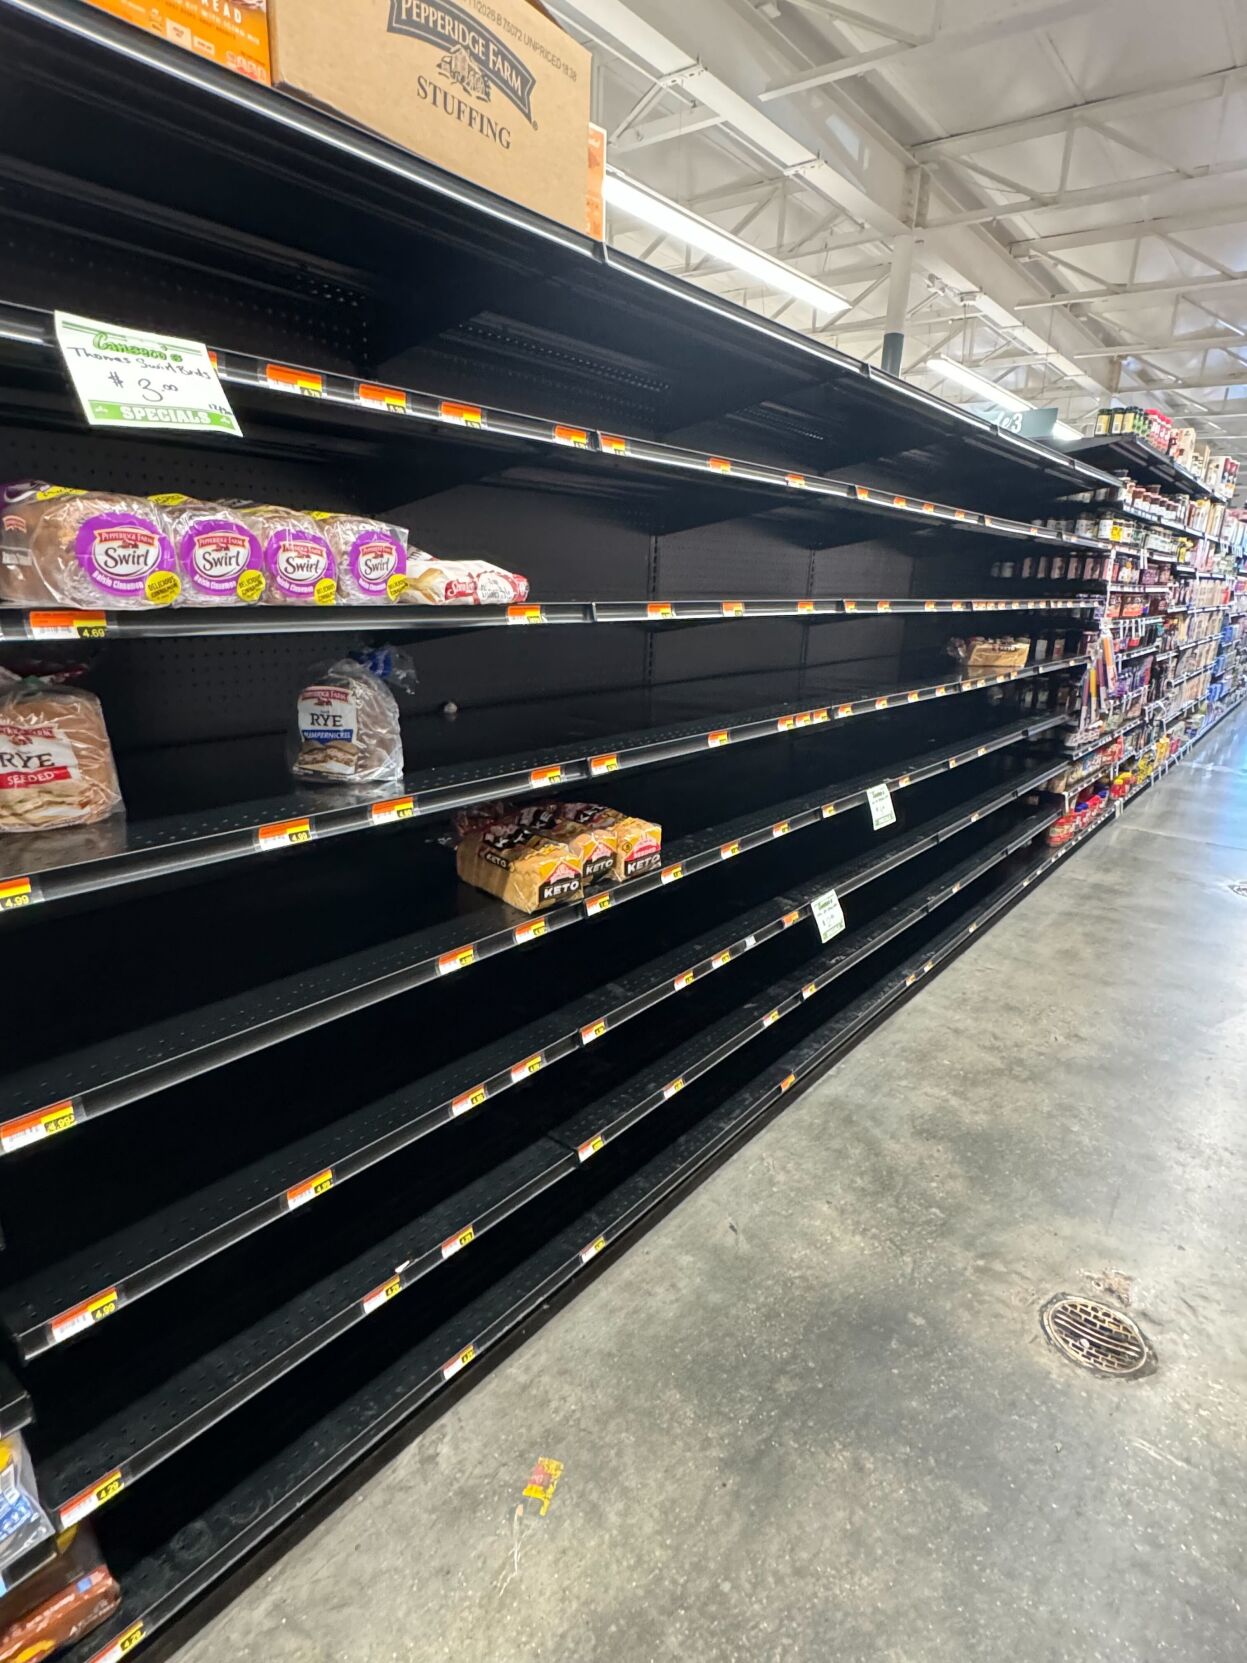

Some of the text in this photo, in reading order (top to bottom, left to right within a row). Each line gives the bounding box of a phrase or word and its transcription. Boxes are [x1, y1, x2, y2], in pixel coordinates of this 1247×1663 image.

[400, 0, 523, 97] PEPPERIDGE FARM
[523, 33, 562, 70] UNPRICED
[416, 75, 512, 150] STUFFING
[120, 406, 211, 424] SPECIALS
[103, 546, 150, 569] Swirl
[202, 550, 241, 572] Swirl
[284, 555, 320, 575] Swirl
[364, 557, 390, 576] Swirl
[309, 712, 343, 728] RYE
[0, 751, 56, 769] RYE
[7, 770, 55, 785] SEEDED
[485, 854, 508, 868] KETO
[585, 859, 614, 876] KETO
[627, 853, 661, 875] KETO
[543, 880, 580, 899] KETO
[4, 894, 30, 909] 4.99
